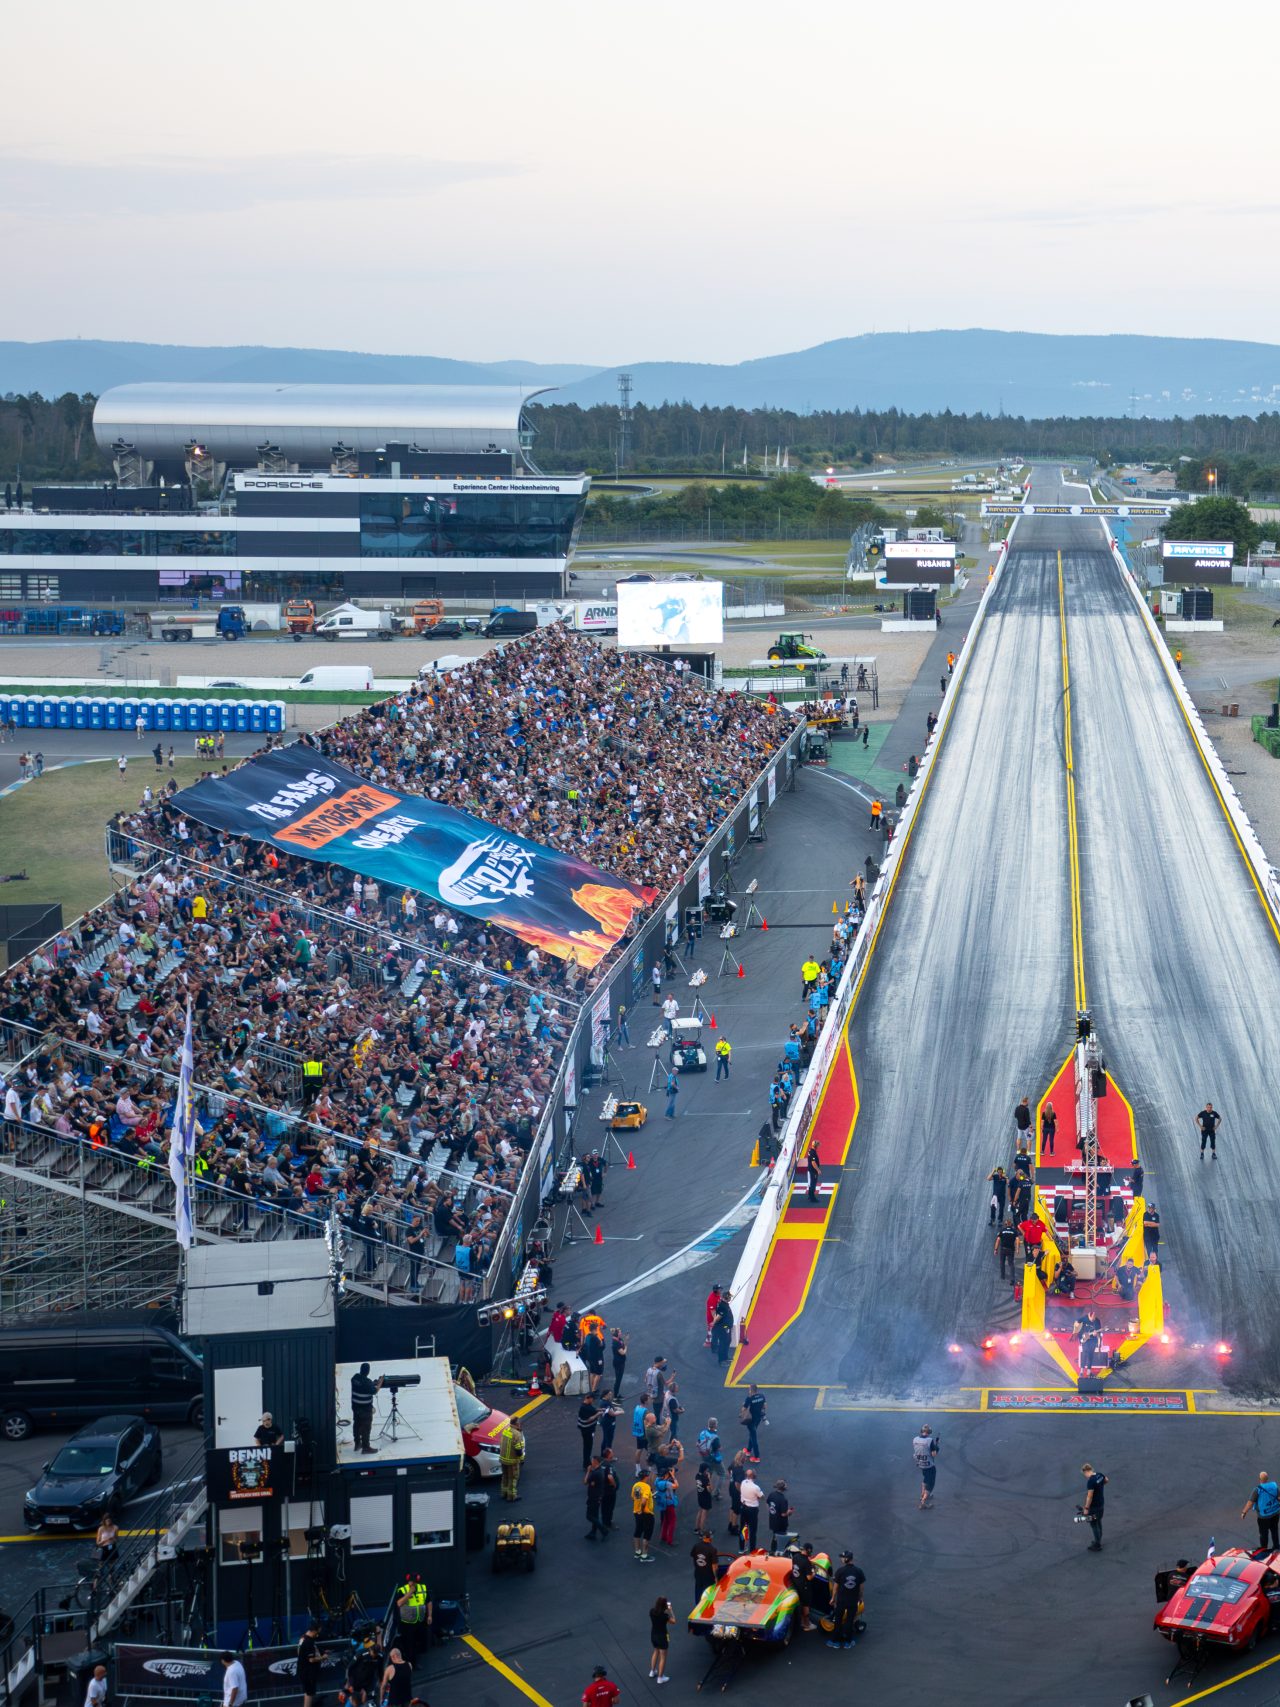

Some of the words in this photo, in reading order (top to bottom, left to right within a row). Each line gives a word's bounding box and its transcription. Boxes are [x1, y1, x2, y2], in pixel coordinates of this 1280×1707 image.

[453, 484, 486, 492] Experience
[510, 484, 559, 492] Hockenheimring
[993, 1395, 1062, 1403] RICO
[1067, 1395, 1183, 1404] ANTHES
[229, 1448, 272, 1463] BENNI
